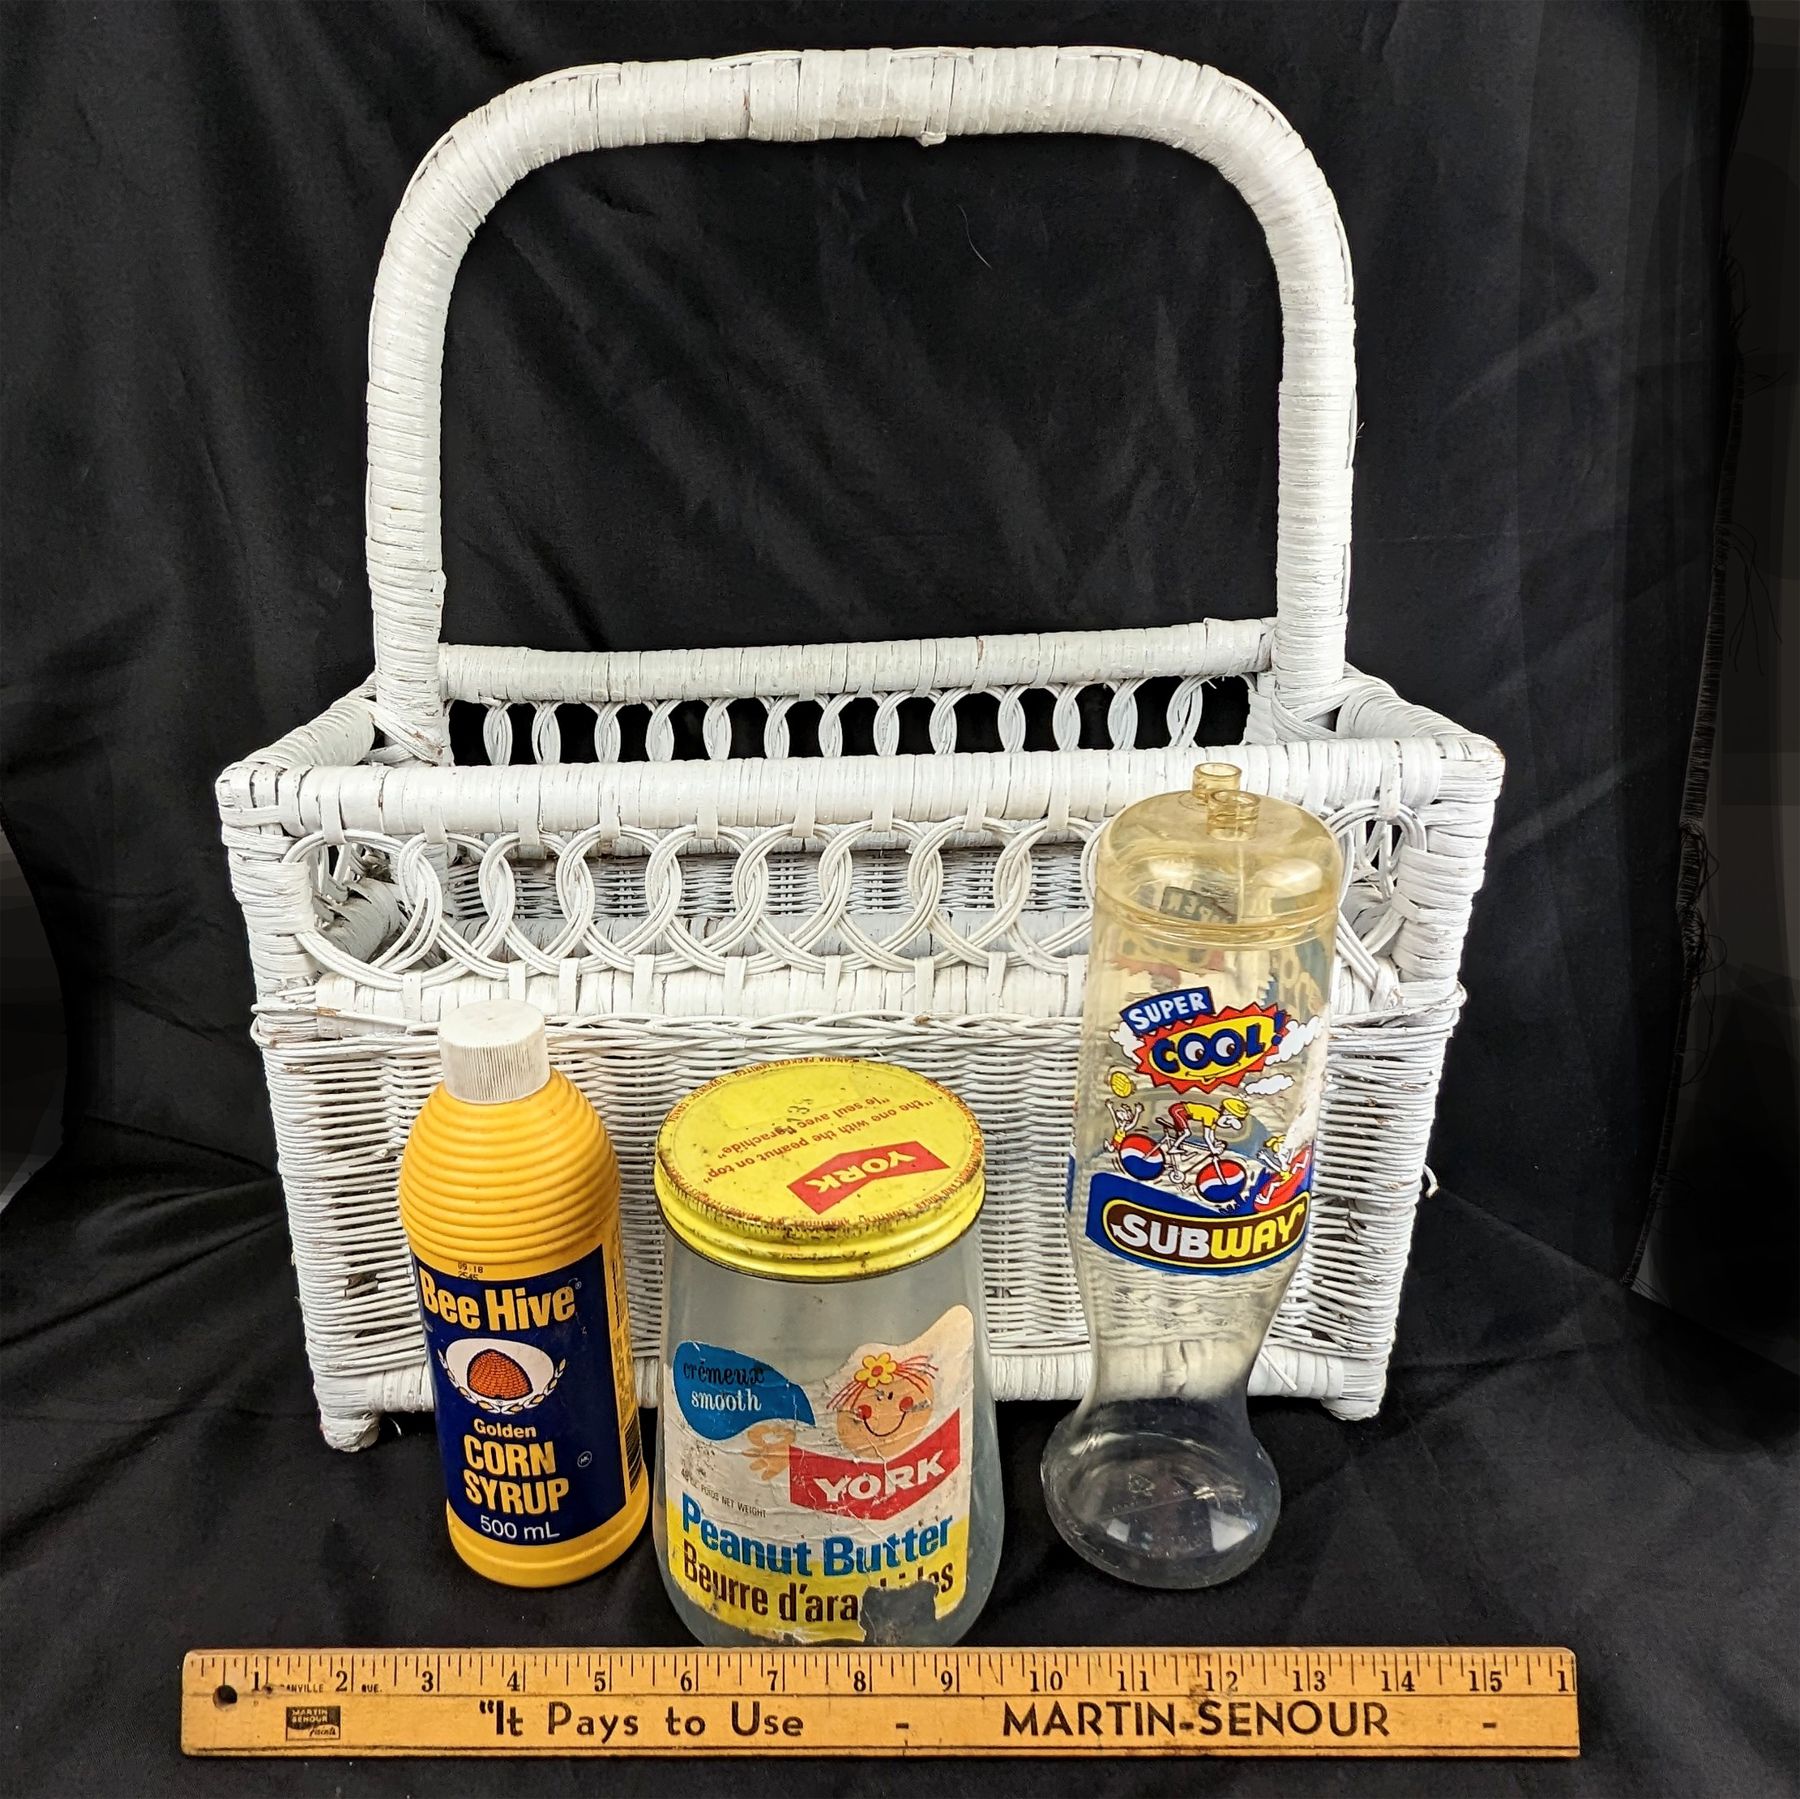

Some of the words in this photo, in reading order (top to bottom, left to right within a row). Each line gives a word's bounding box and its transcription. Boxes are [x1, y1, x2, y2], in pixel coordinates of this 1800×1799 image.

[1128, 991, 1208, 1031] SUPER
[1152, 1009, 1288, 1074] COOL!
[796, 1112, 830, 1129] avec
[832, 1102, 864, 1118] seul
[870, 1109, 897, 1122] one
[812, 1129, 839, 1143] the
[838, 1119, 870, 1134] with
[756, 1136, 810, 1162] peanut
[735, 1156, 756, 1169] on
[805, 1149, 917, 1194] YORK
[1110, 1202, 1306, 1260] SUBWAY
[418, 1265, 481, 1330] Bee
[484, 1284, 577, 1332] Hive
[683, 1359, 765, 1386] crémeux
[691, 1388, 762, 1412] smooth
[473, 1418, 537, 1438] Golden
[463, 1434, 556, 1477] CORN
[813, 1450, 946, 1503] YORK
[463, 1469, 570, 1515] SYRUP
[721, 1495, 735, 1509] NET
[737, 1501, 767, 1519] WEIGHT
[480, 1514, 518, 1540] 500
[523, 1521, 560, 1540] mL
[681, 1491, 812, 1577] Peanut
[822, 1514, 954, 1578] Butter
[683, 1539, 769, 1616] Beurre
[336, 1670, 348, 1692] 2
[421, 1671, 434, 1692] 3
[506, 1670, 521, 1692] 4
[594, 1670, 607, 1692] 5
[680, 1670, 693, 1692] 6
[766, 1670, 779, 1692] 7
[853, 1670, 867, 1692] 8
[940, 1670, 953, 1692] 9
[1029, 1670, 1063, 1692] 10
[1117, 1670, 1150, 1692] 11
[1204, 1670, 1239, 1692] 12
[1292, 1670, 1327, 1692] 13
[1381, 1670, 1415, 1692] 14
[1468, 1670, 1503, 1692] 15
[291, 1715, 328, 1723] SENOUR
[292, 1708, 328, 1716] MARTIN
[548, 1700, 639, 1744] Pays
[665, 1705, 706, 1737] to
[731, 1700, 804, 1737] Use
